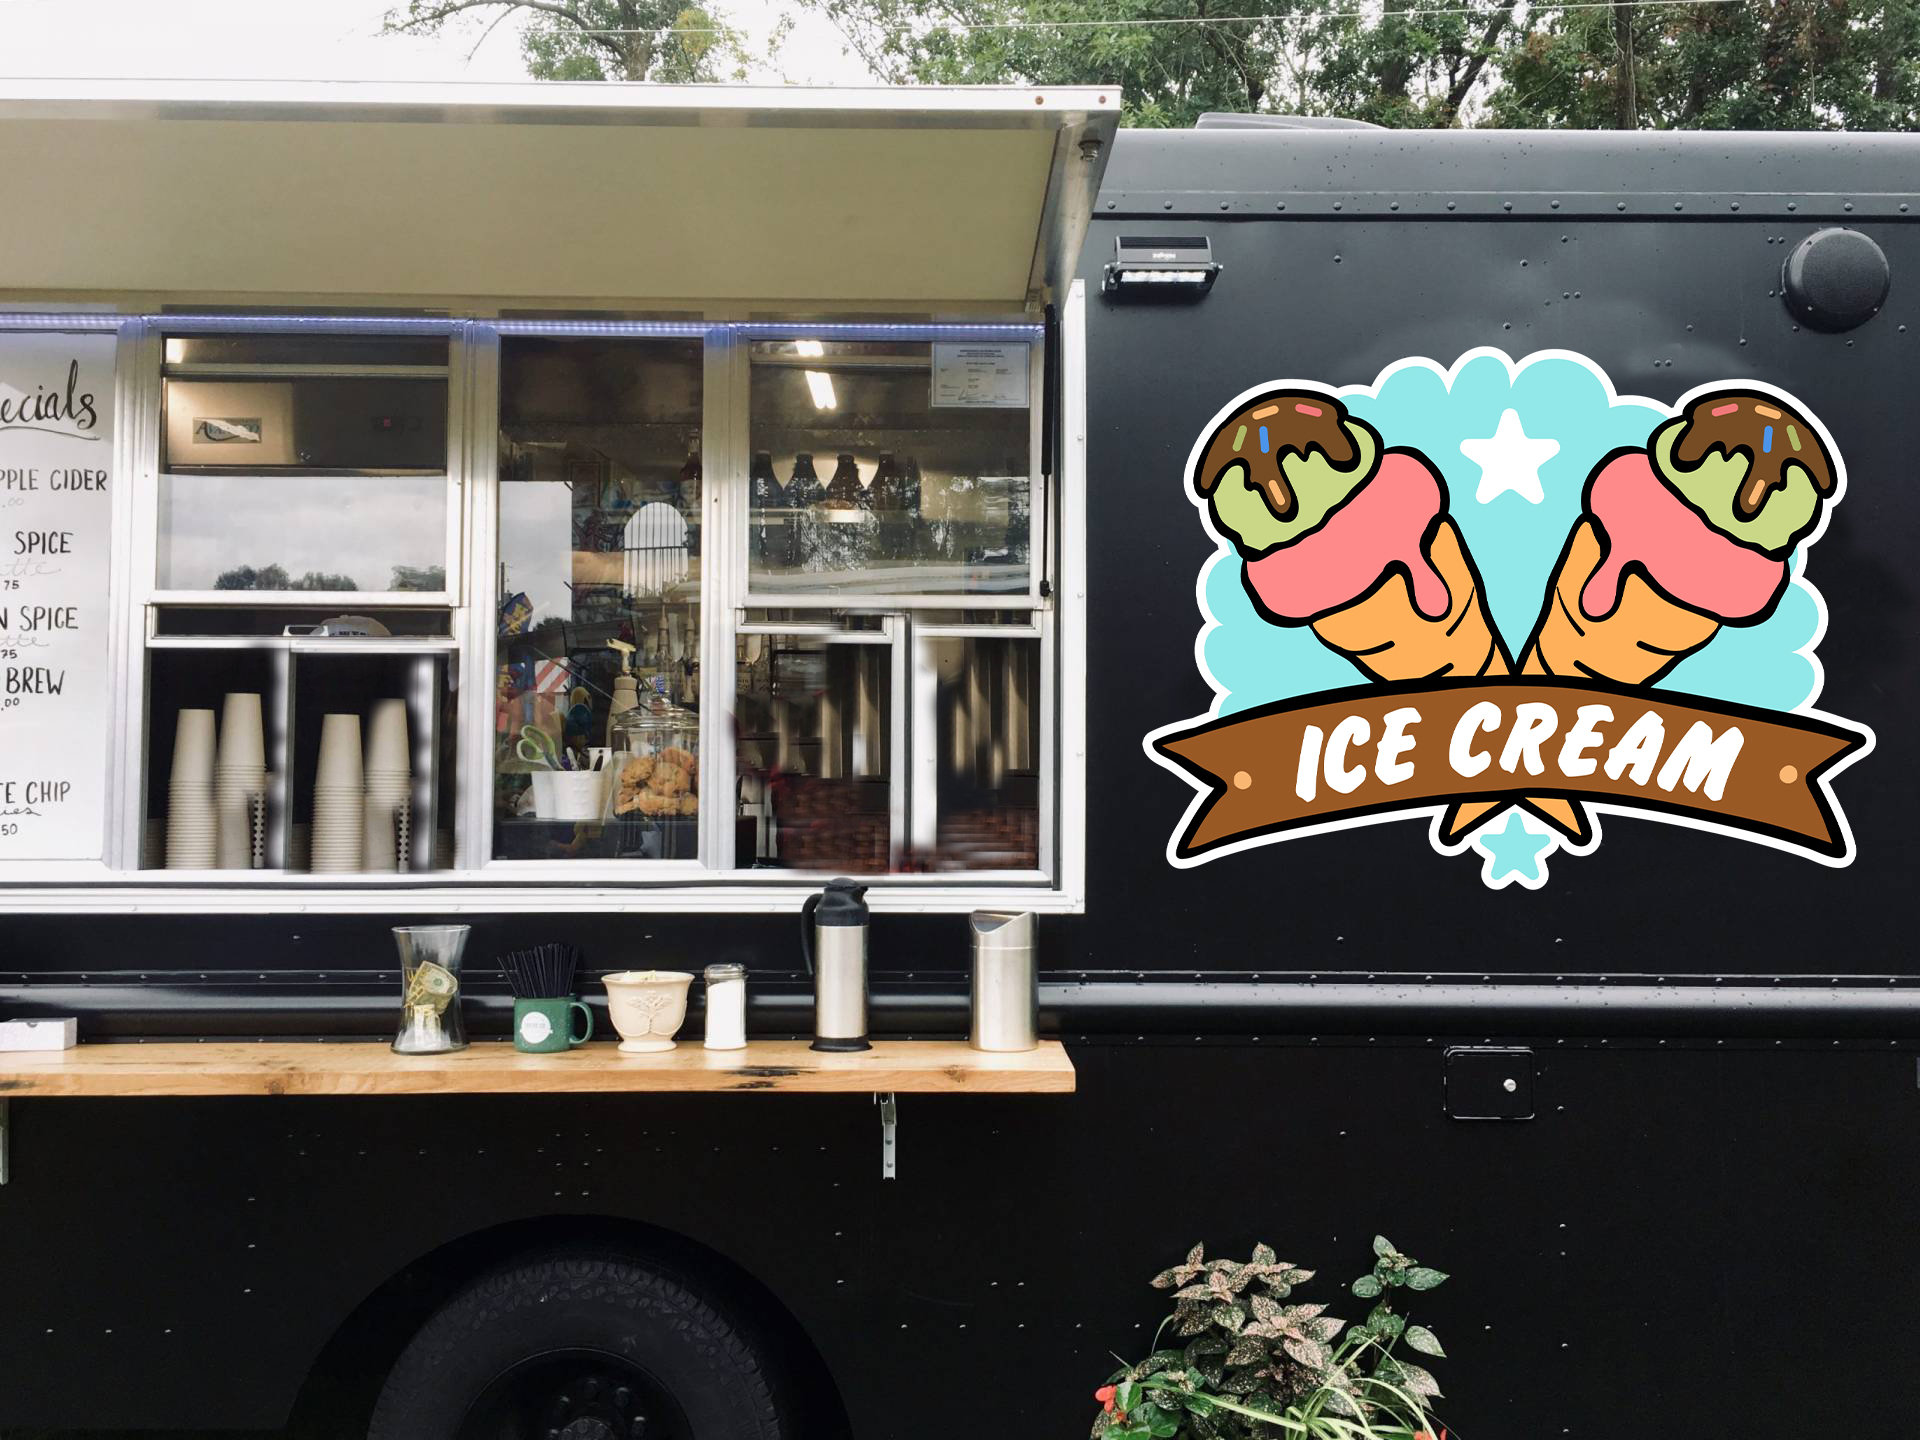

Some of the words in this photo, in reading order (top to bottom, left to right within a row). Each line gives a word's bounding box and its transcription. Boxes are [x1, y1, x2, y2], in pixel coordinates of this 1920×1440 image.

[0, 359, 97, 430] ecials
[50, 469, 107, 491] CIDER
[14, 531, 74, 555] SPICE
[4, 580, 20, 590] 75
[19, 605, 79, 631] SPICE
[1, 649, 18, 659] 75
[6, 666, 65, 695] BREW
[1296, 707, 1422, 802] ICE
[1449, 701, 1744, 801] CREAM
[26, 781, 71, 804] CHIP
